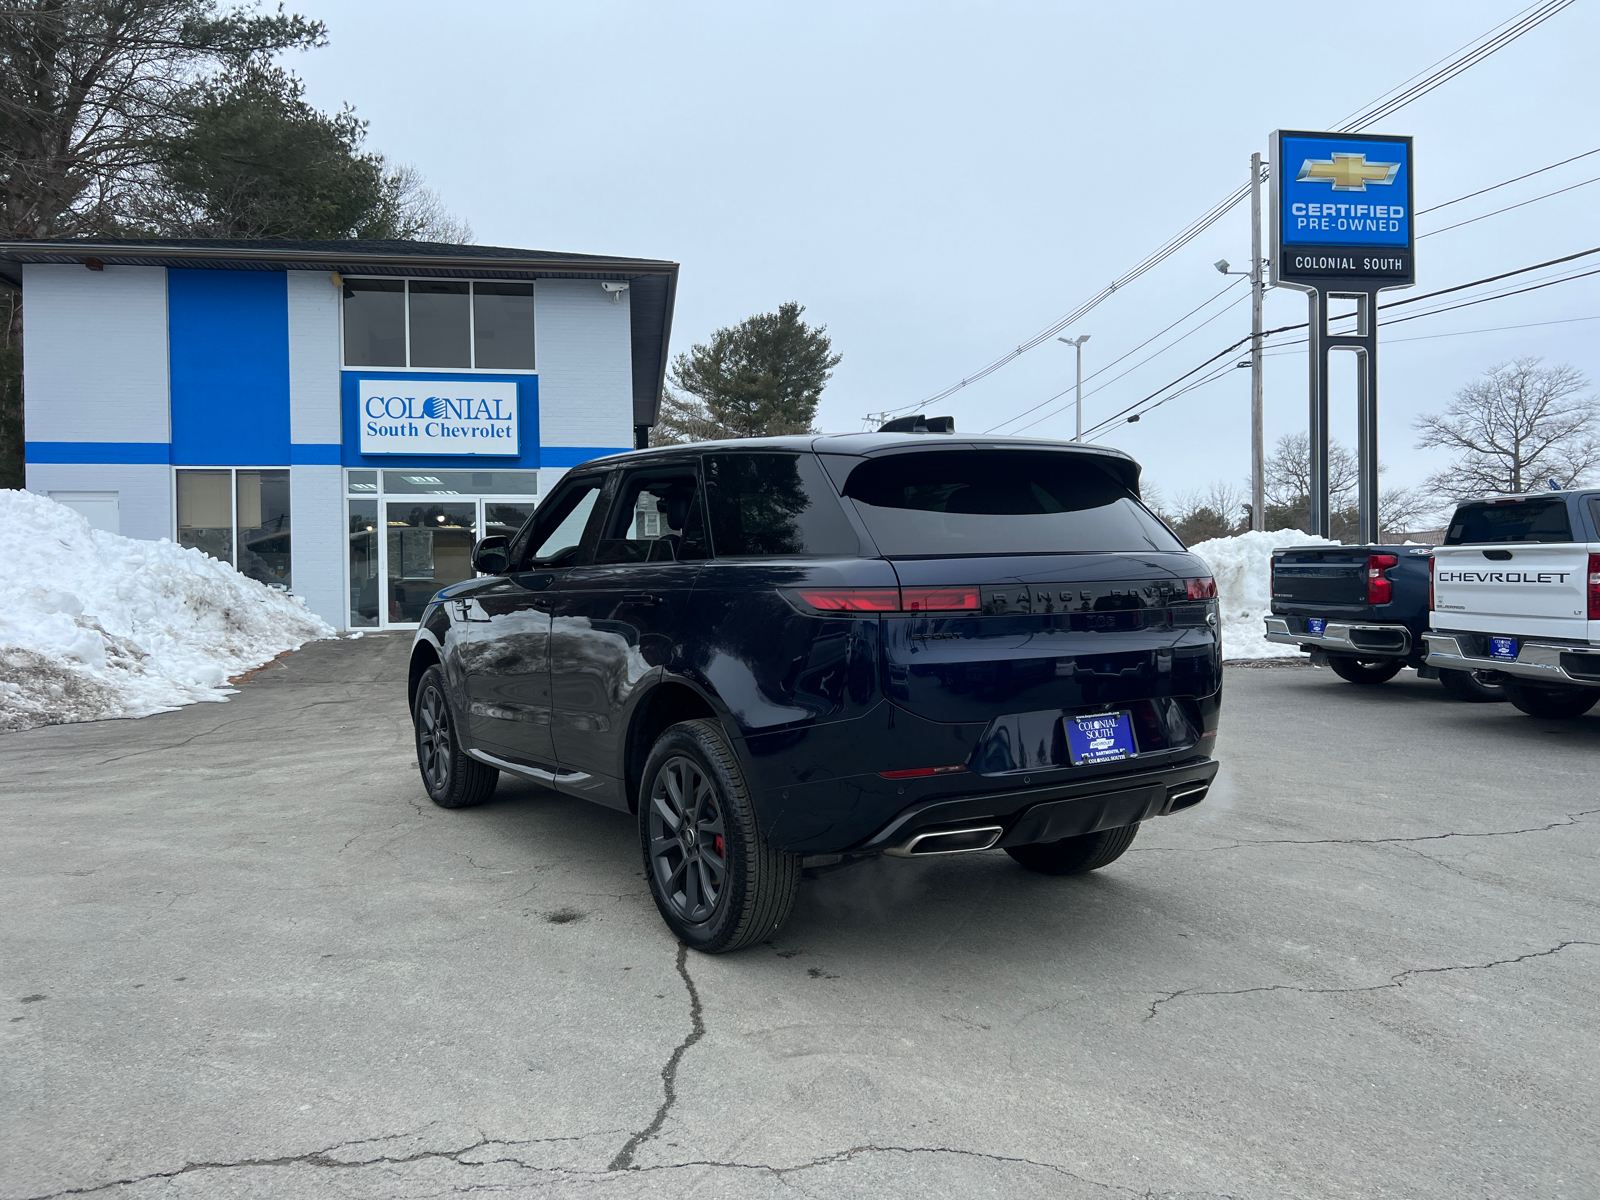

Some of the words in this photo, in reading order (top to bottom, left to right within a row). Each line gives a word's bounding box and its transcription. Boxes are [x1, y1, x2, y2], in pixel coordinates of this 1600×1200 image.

[1292, 203, 1404, 218] CERTIFIED
[1298, 217, 1399, 231] PRE-OWNED
[1295, 257, 1356, 269] COLONIAL
[1364, 258, 1402, 270] SOUTH
[365, 396, 512, 420] COLONIAL
[366, 421, 419, 437] South
[425, 422, 512, 438] Chevrolet
[1439, 572, 1571, 583] CHEVROLET
[992, 590, 1092, 604] RANGE
[1110, 586, 1187, 599] ROVER
[911, 632, 963, 641] SPORT
[1078, 719, 1118, 731] COLONIAL
[1086, 728, 1114, 739] SOUTH
